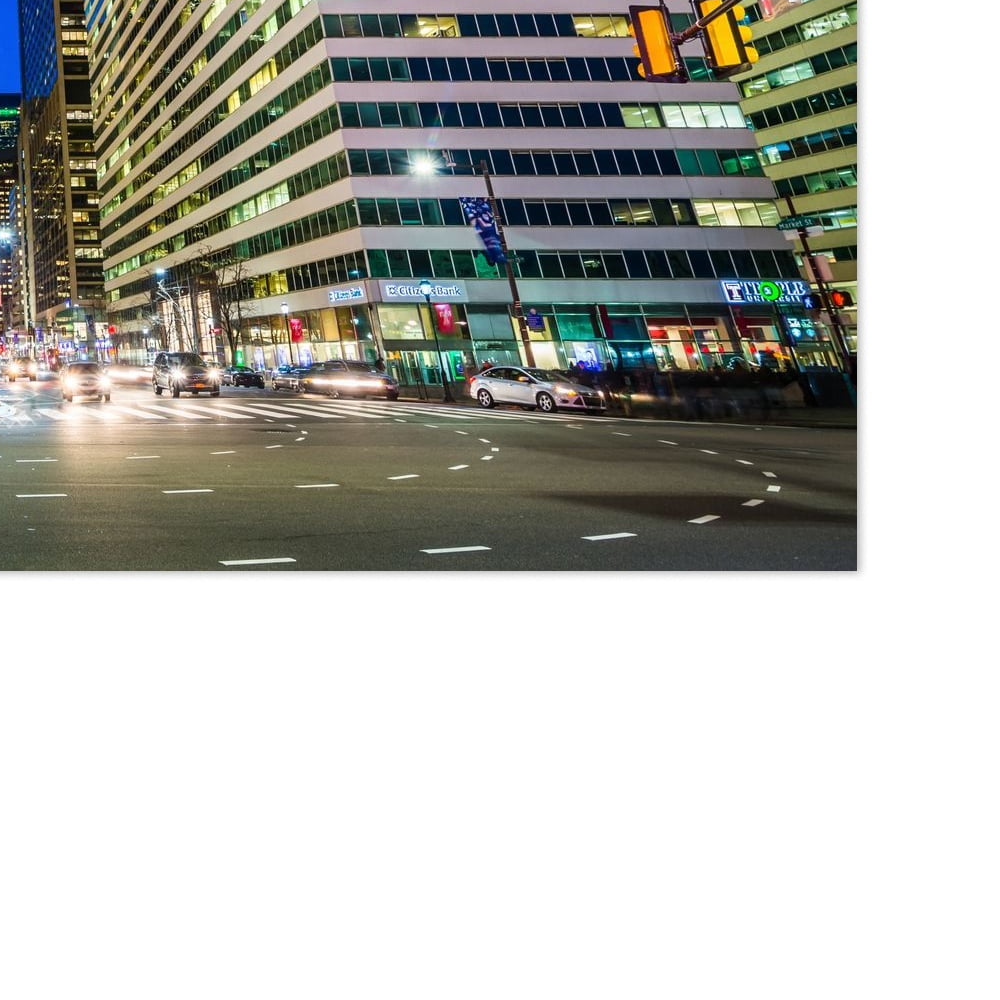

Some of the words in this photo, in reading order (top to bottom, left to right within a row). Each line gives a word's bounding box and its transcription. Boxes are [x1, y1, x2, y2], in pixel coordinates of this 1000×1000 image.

[779, 221, 803, 229] Market
[437, 286, 462, 296] Bank
[740, 281, 806, 296] TEPLE
